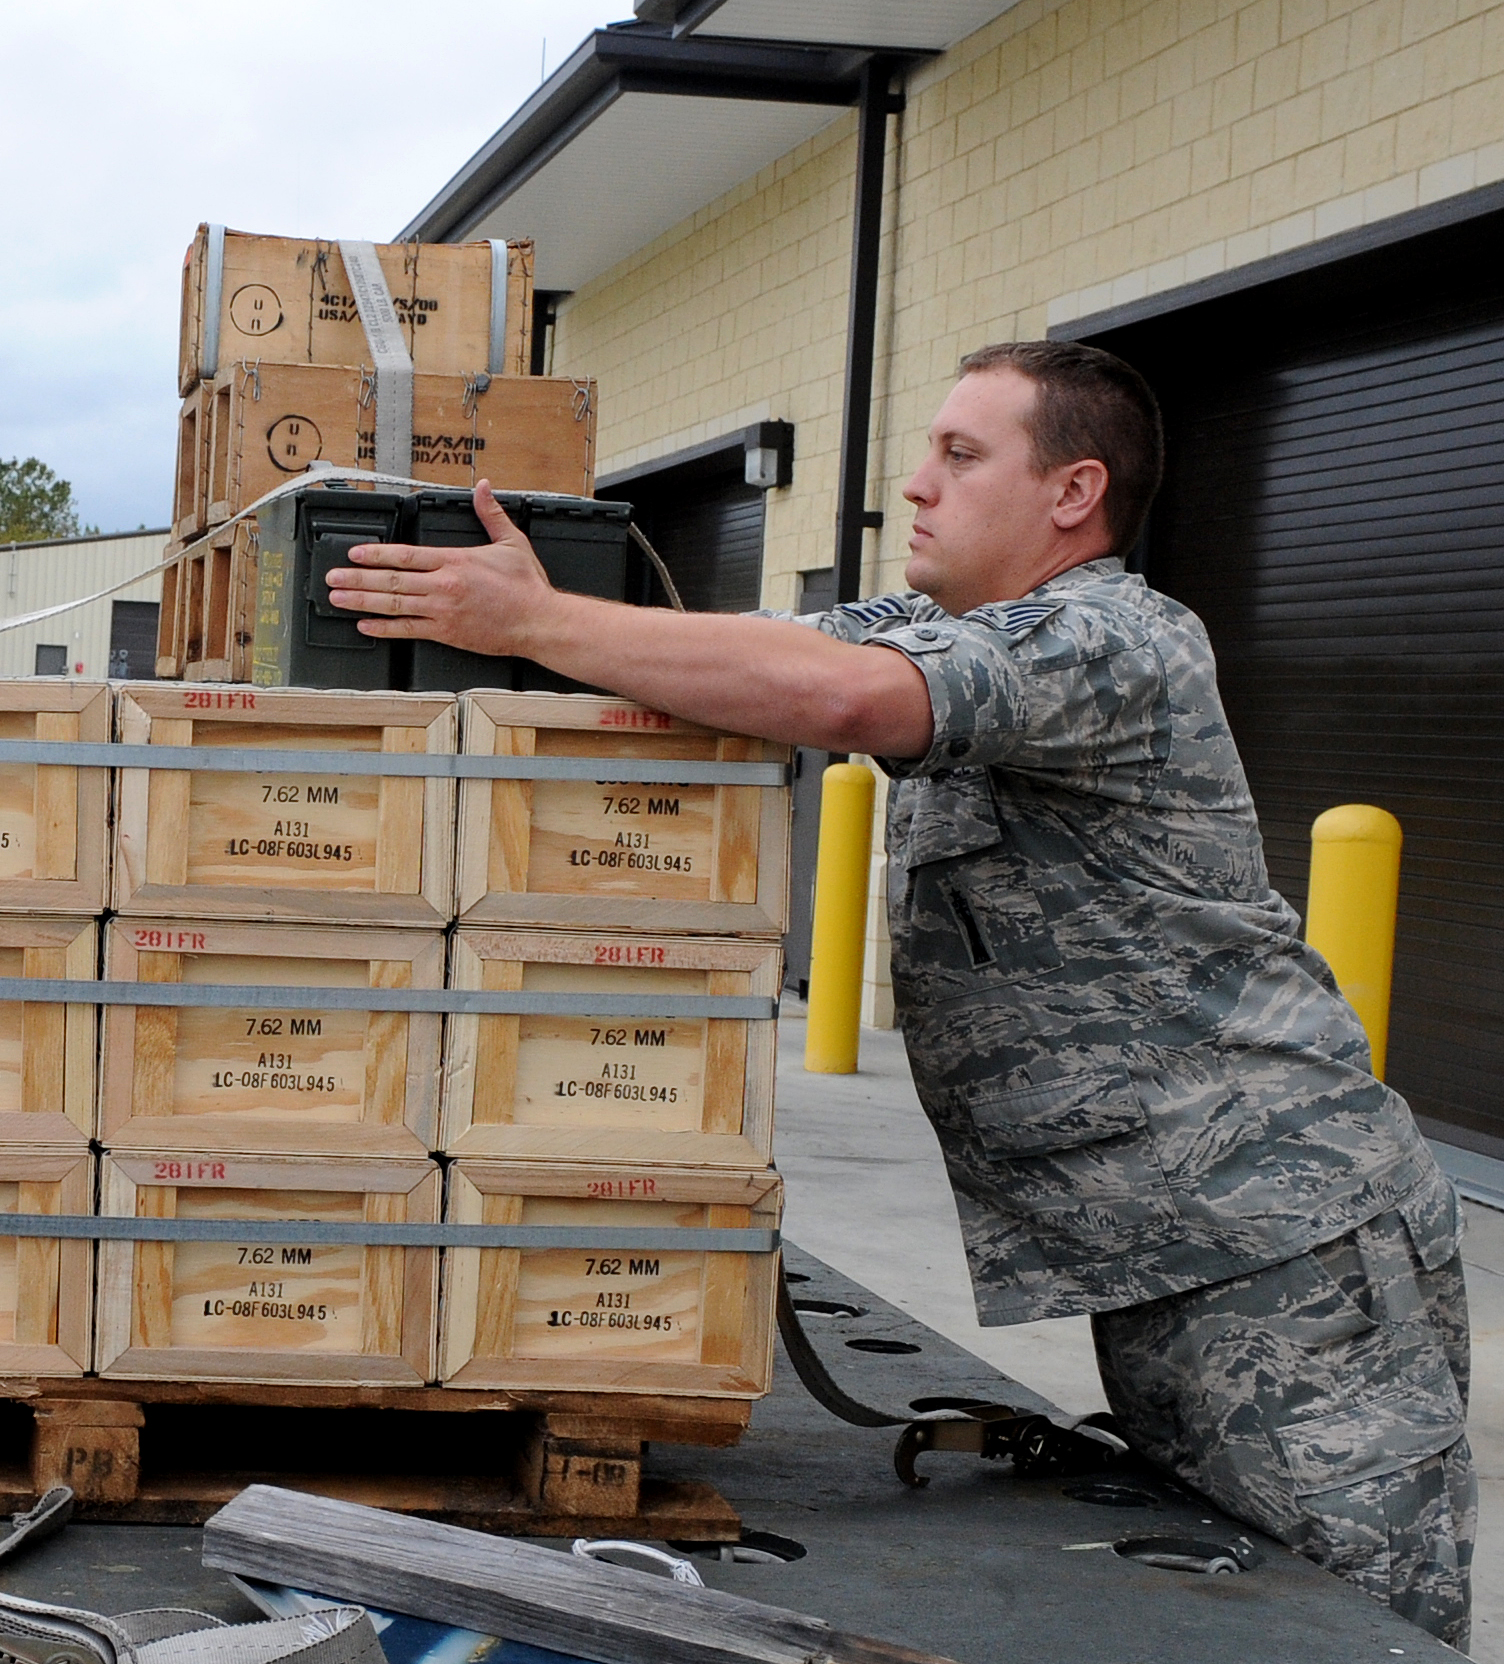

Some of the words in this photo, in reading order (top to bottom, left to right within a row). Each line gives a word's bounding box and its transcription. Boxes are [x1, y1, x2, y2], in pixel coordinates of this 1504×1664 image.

[184, 693, 256, 709] 281FR
[262, 786, 299, 802] 7.62
[307, 787, 338, 804] MM
[603, 797, 640, 814] 7.62
[648, 798, 679, 815] MM
[274, 821, 308, 837] A131
[615, 832, 648, 849] A131
[225, 839, 352, 861] LC-08F603L945
[567, 850, 691, 872] LC-08F603L945
[135, 929, 205, 948] 281FR
[595, 946, 665, 965] 281FR
[246, 1019, 282, 1035] 7.62
[291, 1019, 321, 1035] MM
[591, 1029, 626, 1045] 7.62
[635, 1030, 665, 1046] MM
[258, 1053, 291, 1069] A131
[602, 1063, 635, 1080] A131
[212, 1072, 334, 1092] LC-08F603L945
[555, 1081, 677, 1103] LC-08F603L945
[155, 1162, 225, 1179] 281FR
[588, 1180, 656, 1196] 281FR
[238, 1248, 273, 1264] 7.62
[282, 1248, 311, 1264] MM
[586, 1259, 621, 1275] 7.62
[629, 1259, 659, 1275] MM
[249, 1282, 282, 1298] A131
[596, 1293, 629, 1309] A131
[204, 1300, 326, 1320] LC-08F603L945
[547, 1311, 671, 1331] LC-08F603L945
